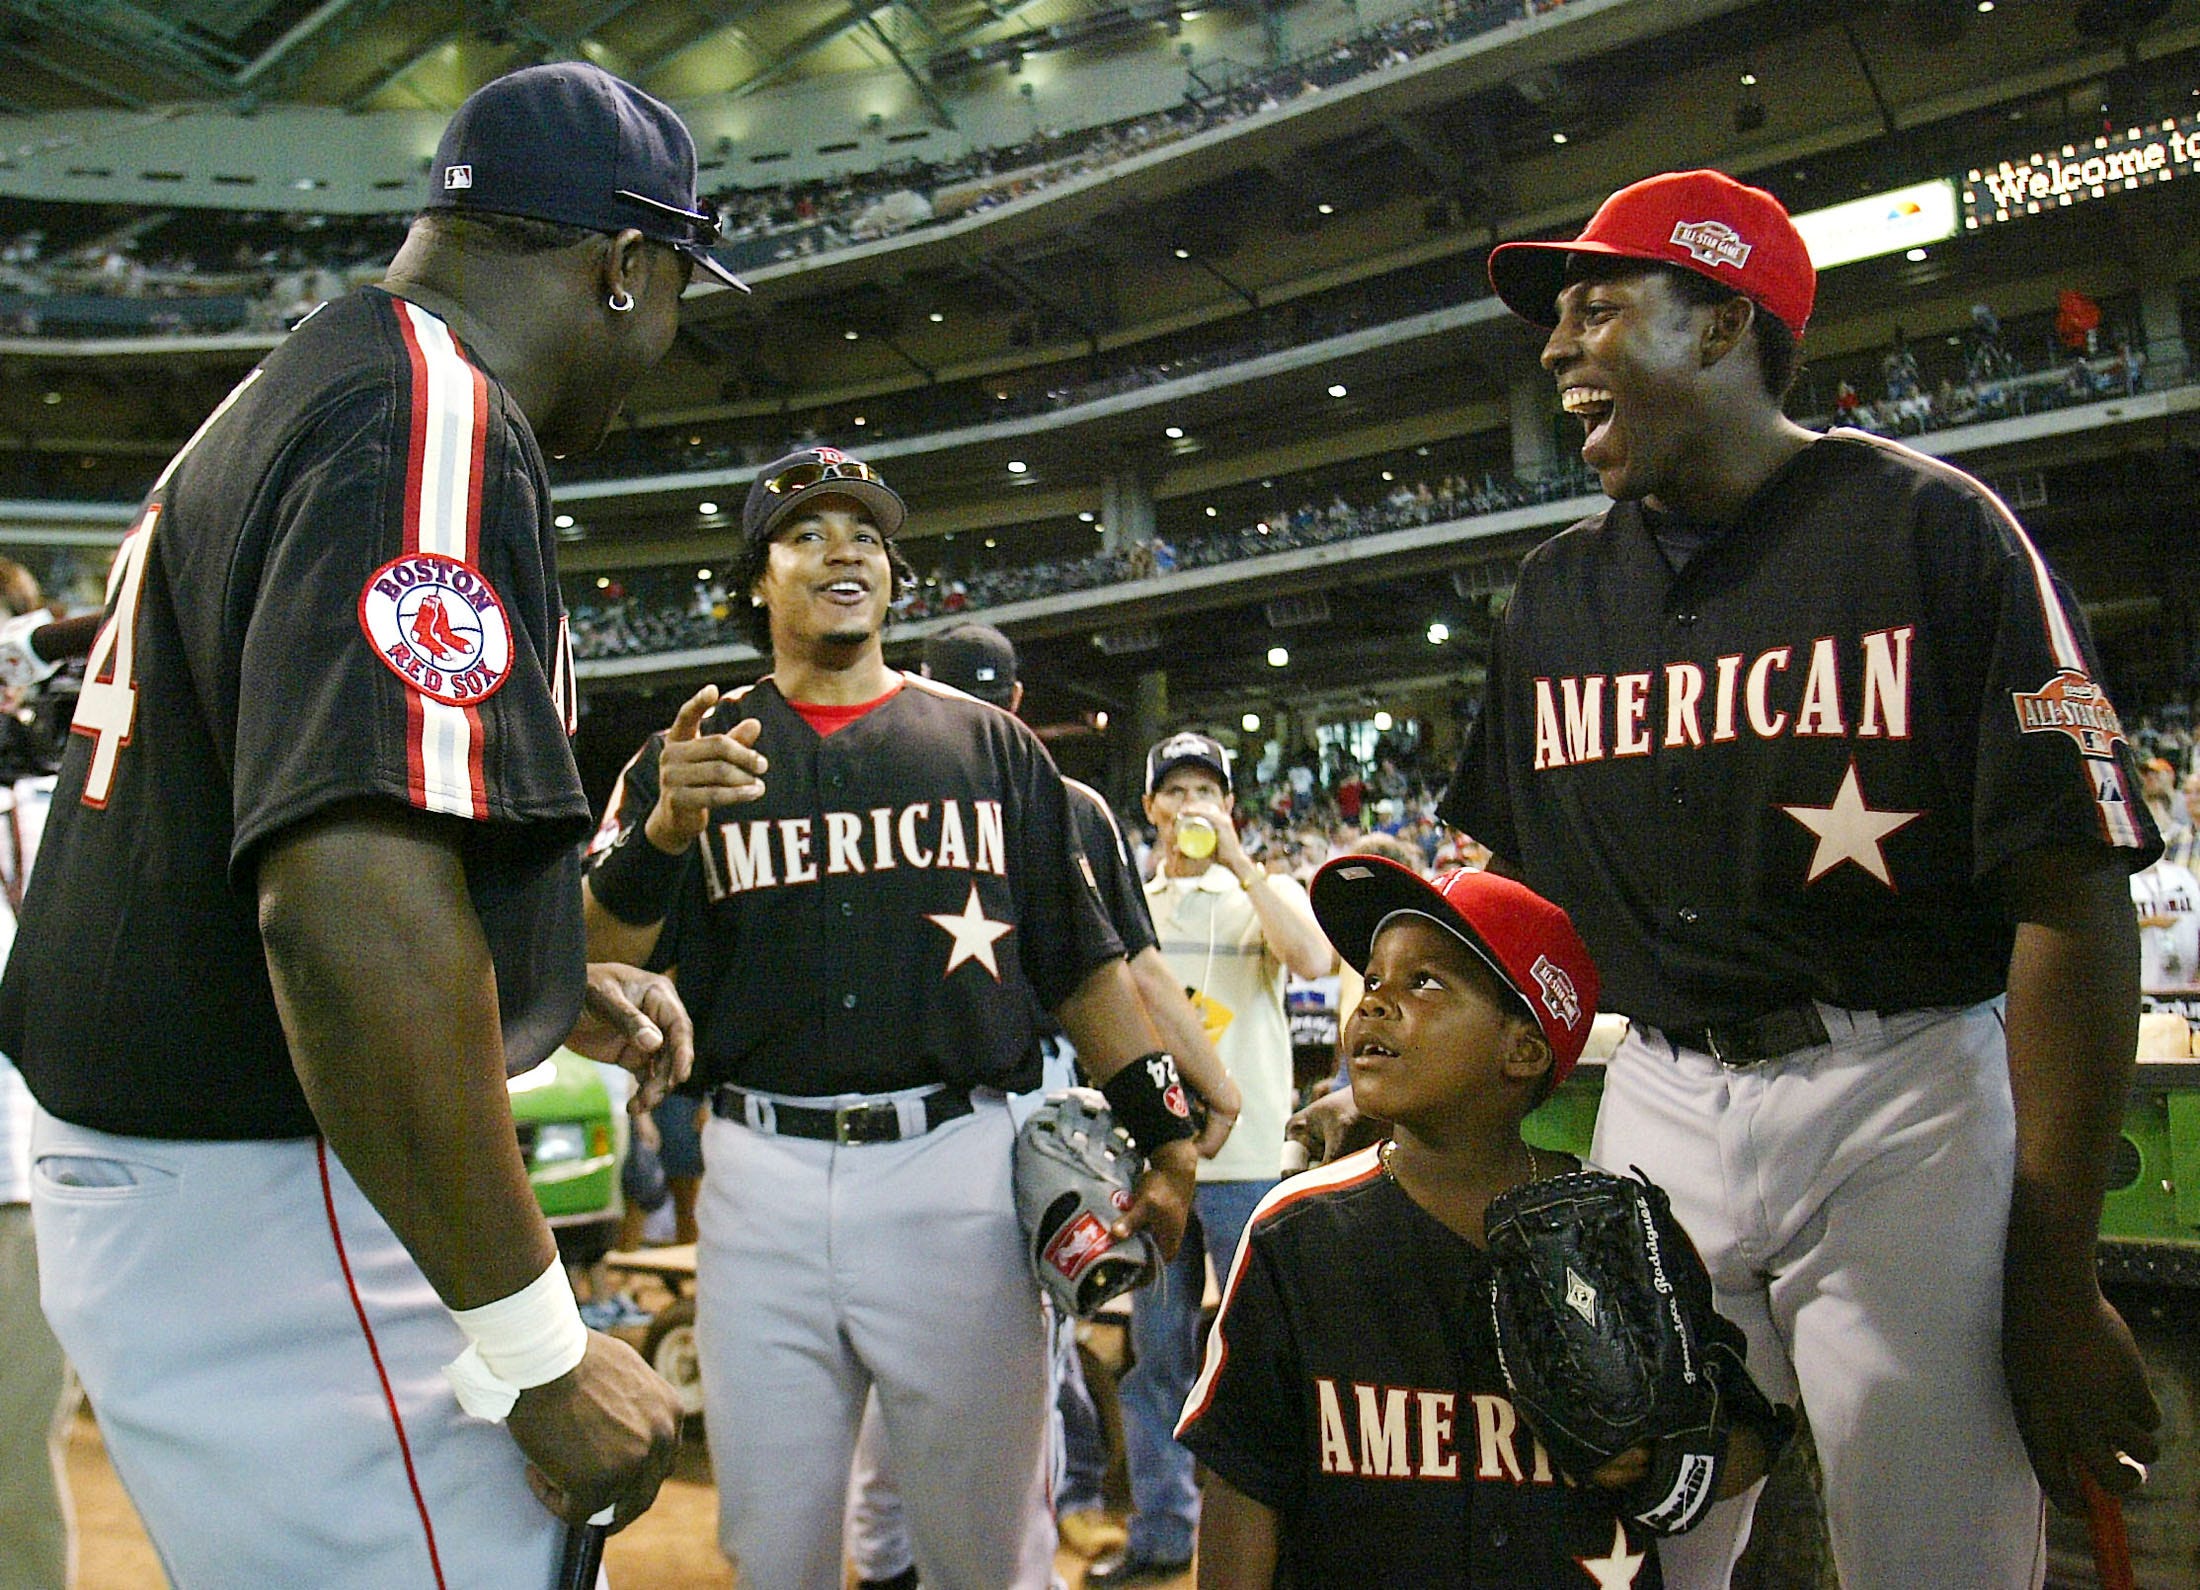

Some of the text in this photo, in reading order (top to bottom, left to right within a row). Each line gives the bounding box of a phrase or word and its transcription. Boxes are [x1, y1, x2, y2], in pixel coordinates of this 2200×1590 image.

[1984, 142, 2167, 208] Welcome
[374, 558, 498, 614] BOSTON
[386, 641, 502, 699] RED SOX
[1533, 623, 1915, 770] AMERICAN
[1147, 1054, 1179, 1089] 24
[1636, 1196, 1674, 1294] Rodriguez
